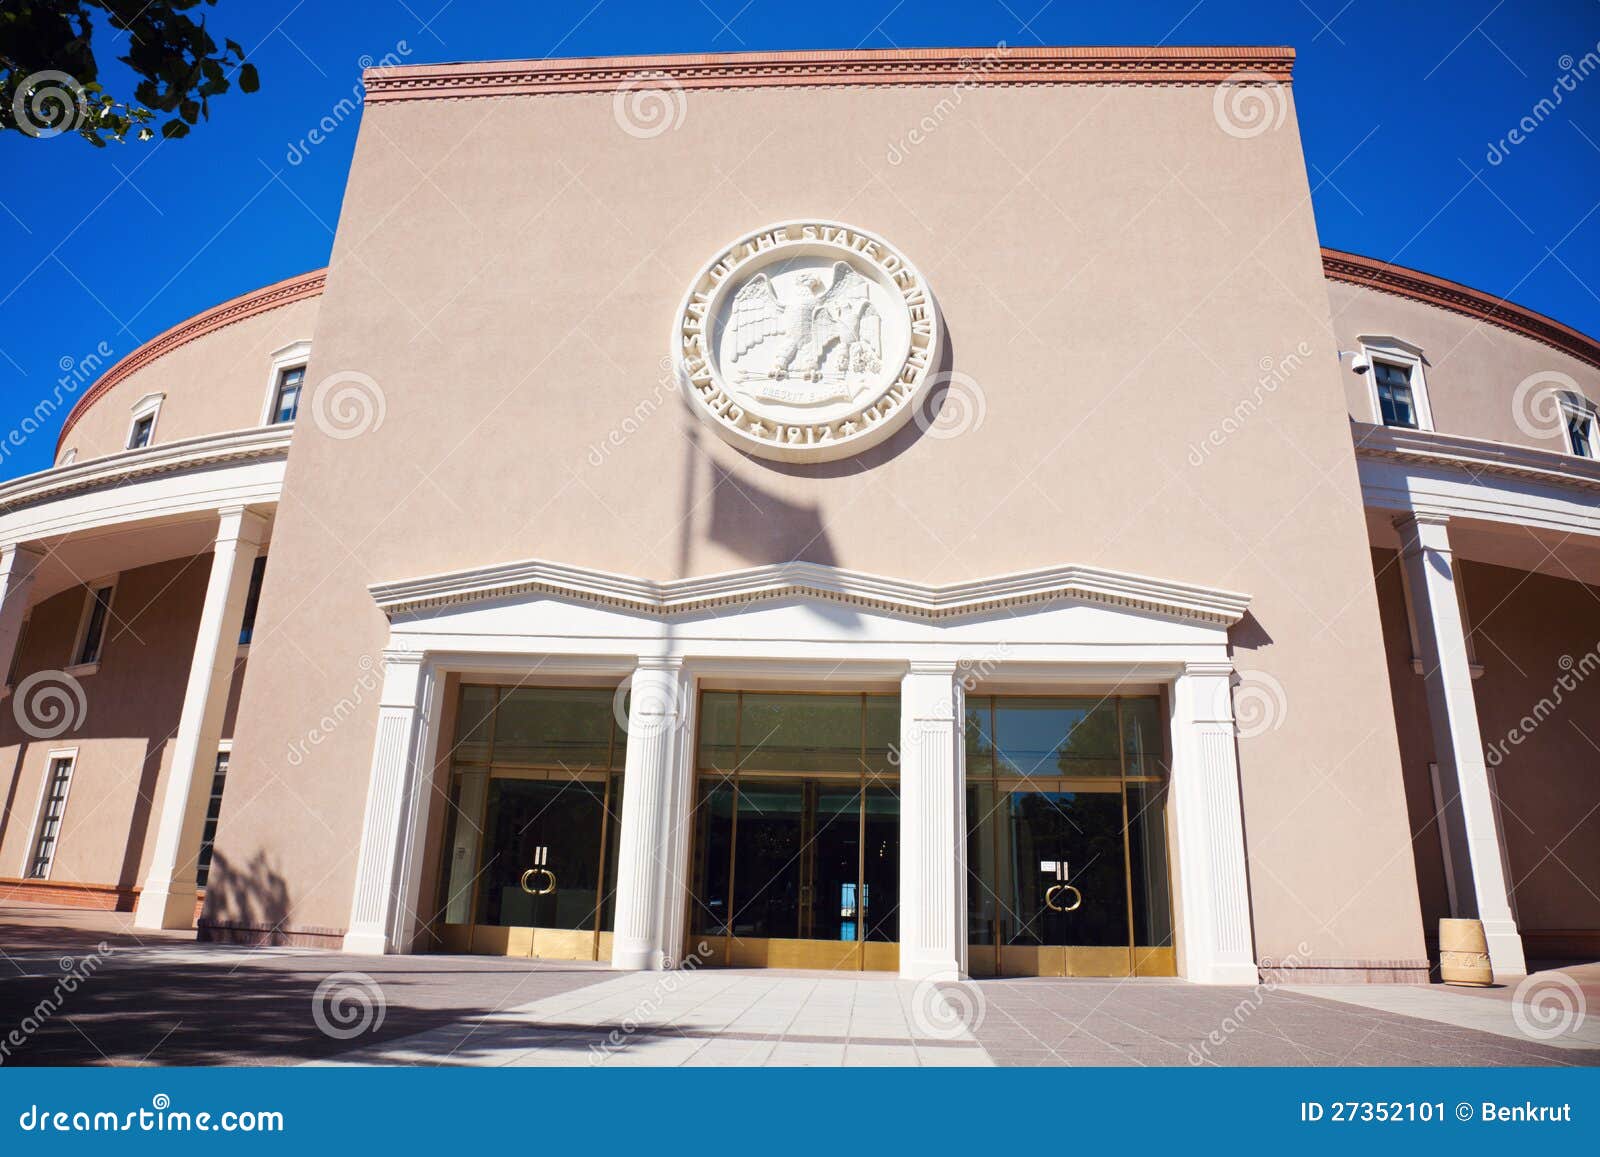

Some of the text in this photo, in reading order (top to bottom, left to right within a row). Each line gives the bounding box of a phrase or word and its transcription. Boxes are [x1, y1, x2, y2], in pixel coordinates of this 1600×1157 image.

[741, 228, 789, 256] THE
[801, 225, 881, 256] STATE
[709, 255, 737, 282] OF
[882, 255, 914, 284] OF
[683, 289, 716, 348] SEAL
[903, 288, 932, 336] NEW
[862, 346, 929, 425] MEXICO
[775, 424, 836, 444] 1912
